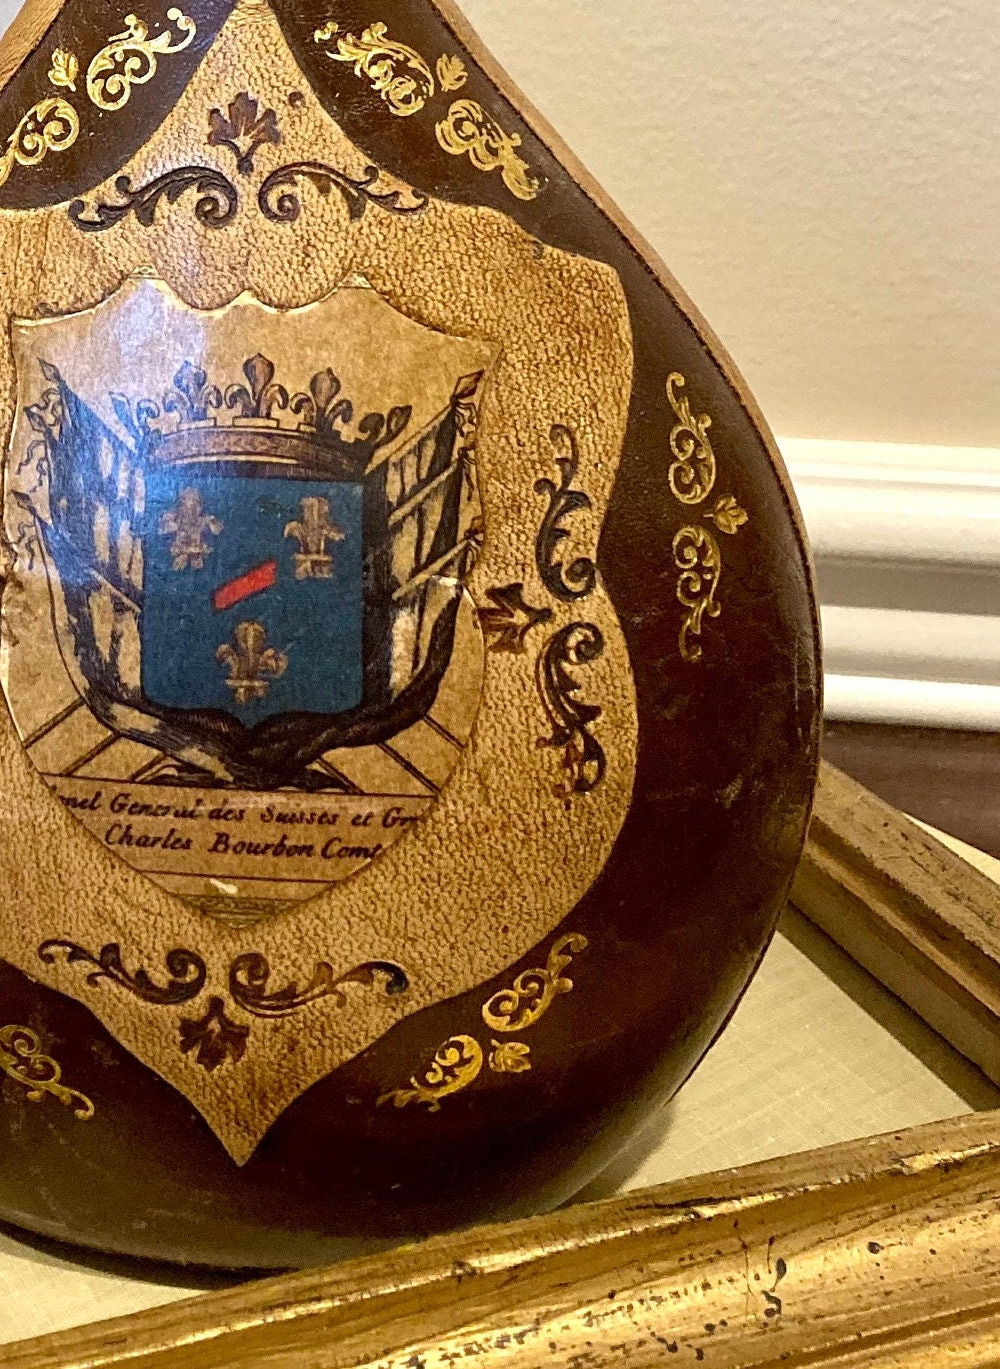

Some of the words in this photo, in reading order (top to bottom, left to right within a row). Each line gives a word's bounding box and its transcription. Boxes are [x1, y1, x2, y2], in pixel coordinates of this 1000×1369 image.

[208, 798, 245, 821] des
[261, 804, 339, 825] Suisses
[351, 811, 374, 827] et
[104, 823, 194, 850] Charles
[207, 832, 314, 857] Bourbon
